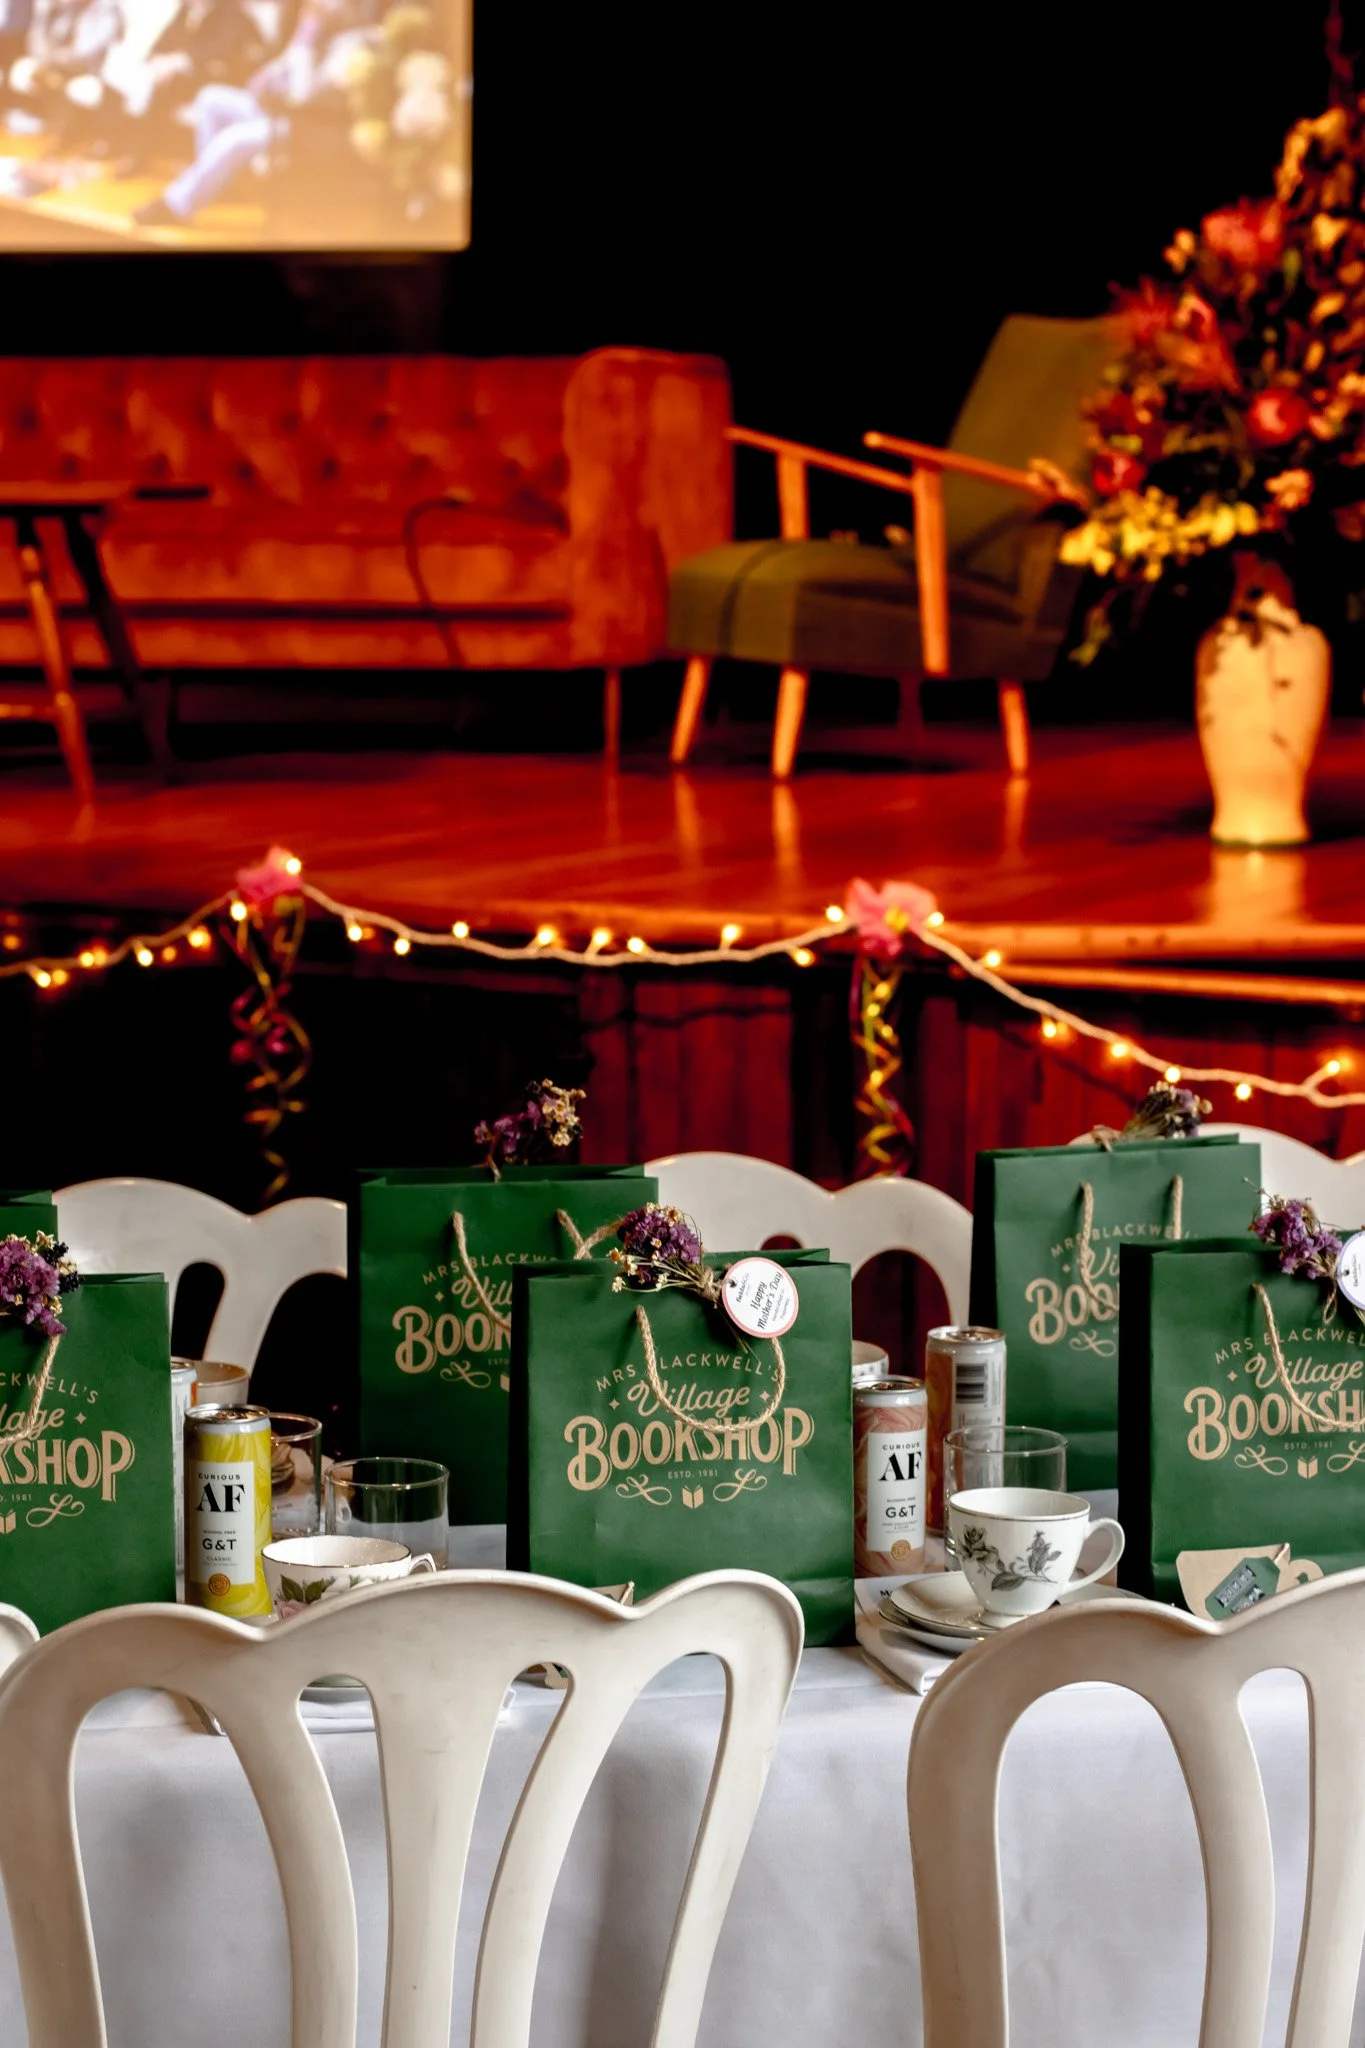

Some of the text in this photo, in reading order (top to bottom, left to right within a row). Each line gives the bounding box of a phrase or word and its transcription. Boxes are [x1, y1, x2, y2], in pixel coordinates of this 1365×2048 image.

[1092, 1223, 1198, 1241] BLACKWE
[423, 1252, 557, 1285] MRS BLACKW
[768, 1271, 784, 1291] Day
[750, 1281, 768, 1311] Happy
[1215, 1337, 1254, 1364] MRS
[596, 1353, 780, 1392] MRS LACKWELL'S
[1244, 1352, 1364, 1392] Village
[627, 1379, 750, 1418] Village
[564, 1407, 814, 1491] BOOKSHOP
[198, 1473, 241, 1481] CURIOUS
[667, 1469, 718, 1479] ESTD. 1981
[879, 1451, 922, 1481] AF
[195, 1483, 246, 1513] AF
